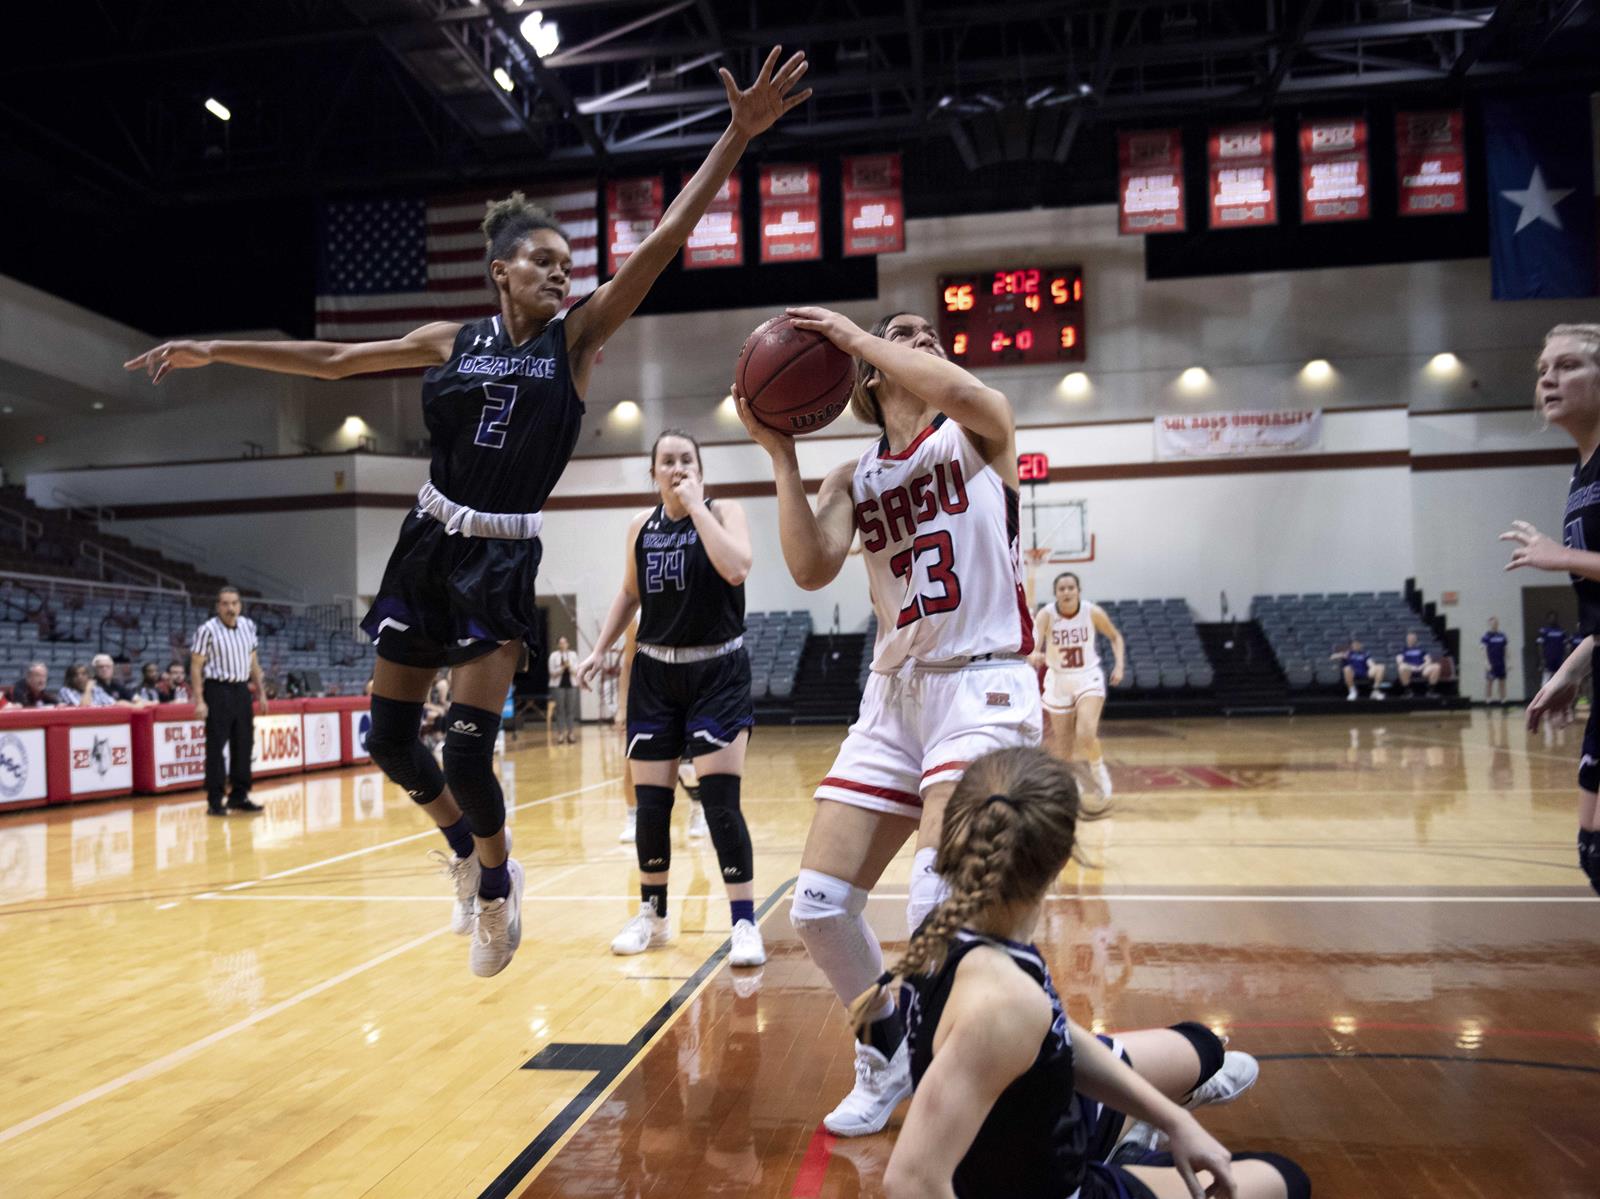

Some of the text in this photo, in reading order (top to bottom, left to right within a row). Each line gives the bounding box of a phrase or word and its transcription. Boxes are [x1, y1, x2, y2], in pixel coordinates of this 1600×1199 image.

[992, 269, 1041, 296] 2:02
[1050, 277, 1083, 305] 51
[944, 284, 975, 312] 56
[1025, 294, 1041, 313] 4
[474, 381, 518, 449] 2
[1018, 454, 1048, 480] 20
[856, 460, 969, 553] SASU
[646, 549, 685, 593] 24
[890, 529, 961, 630] 23
[1052, 627, 1089, 646] SASU
[1059, 646, 1085, 669] 30
[191, 725, 207, 740] RO
[261, 726, 300, 761] LOBOS
[175, 742, 207, 759] STAT
[160, 760, 207, 779] UNIVER
